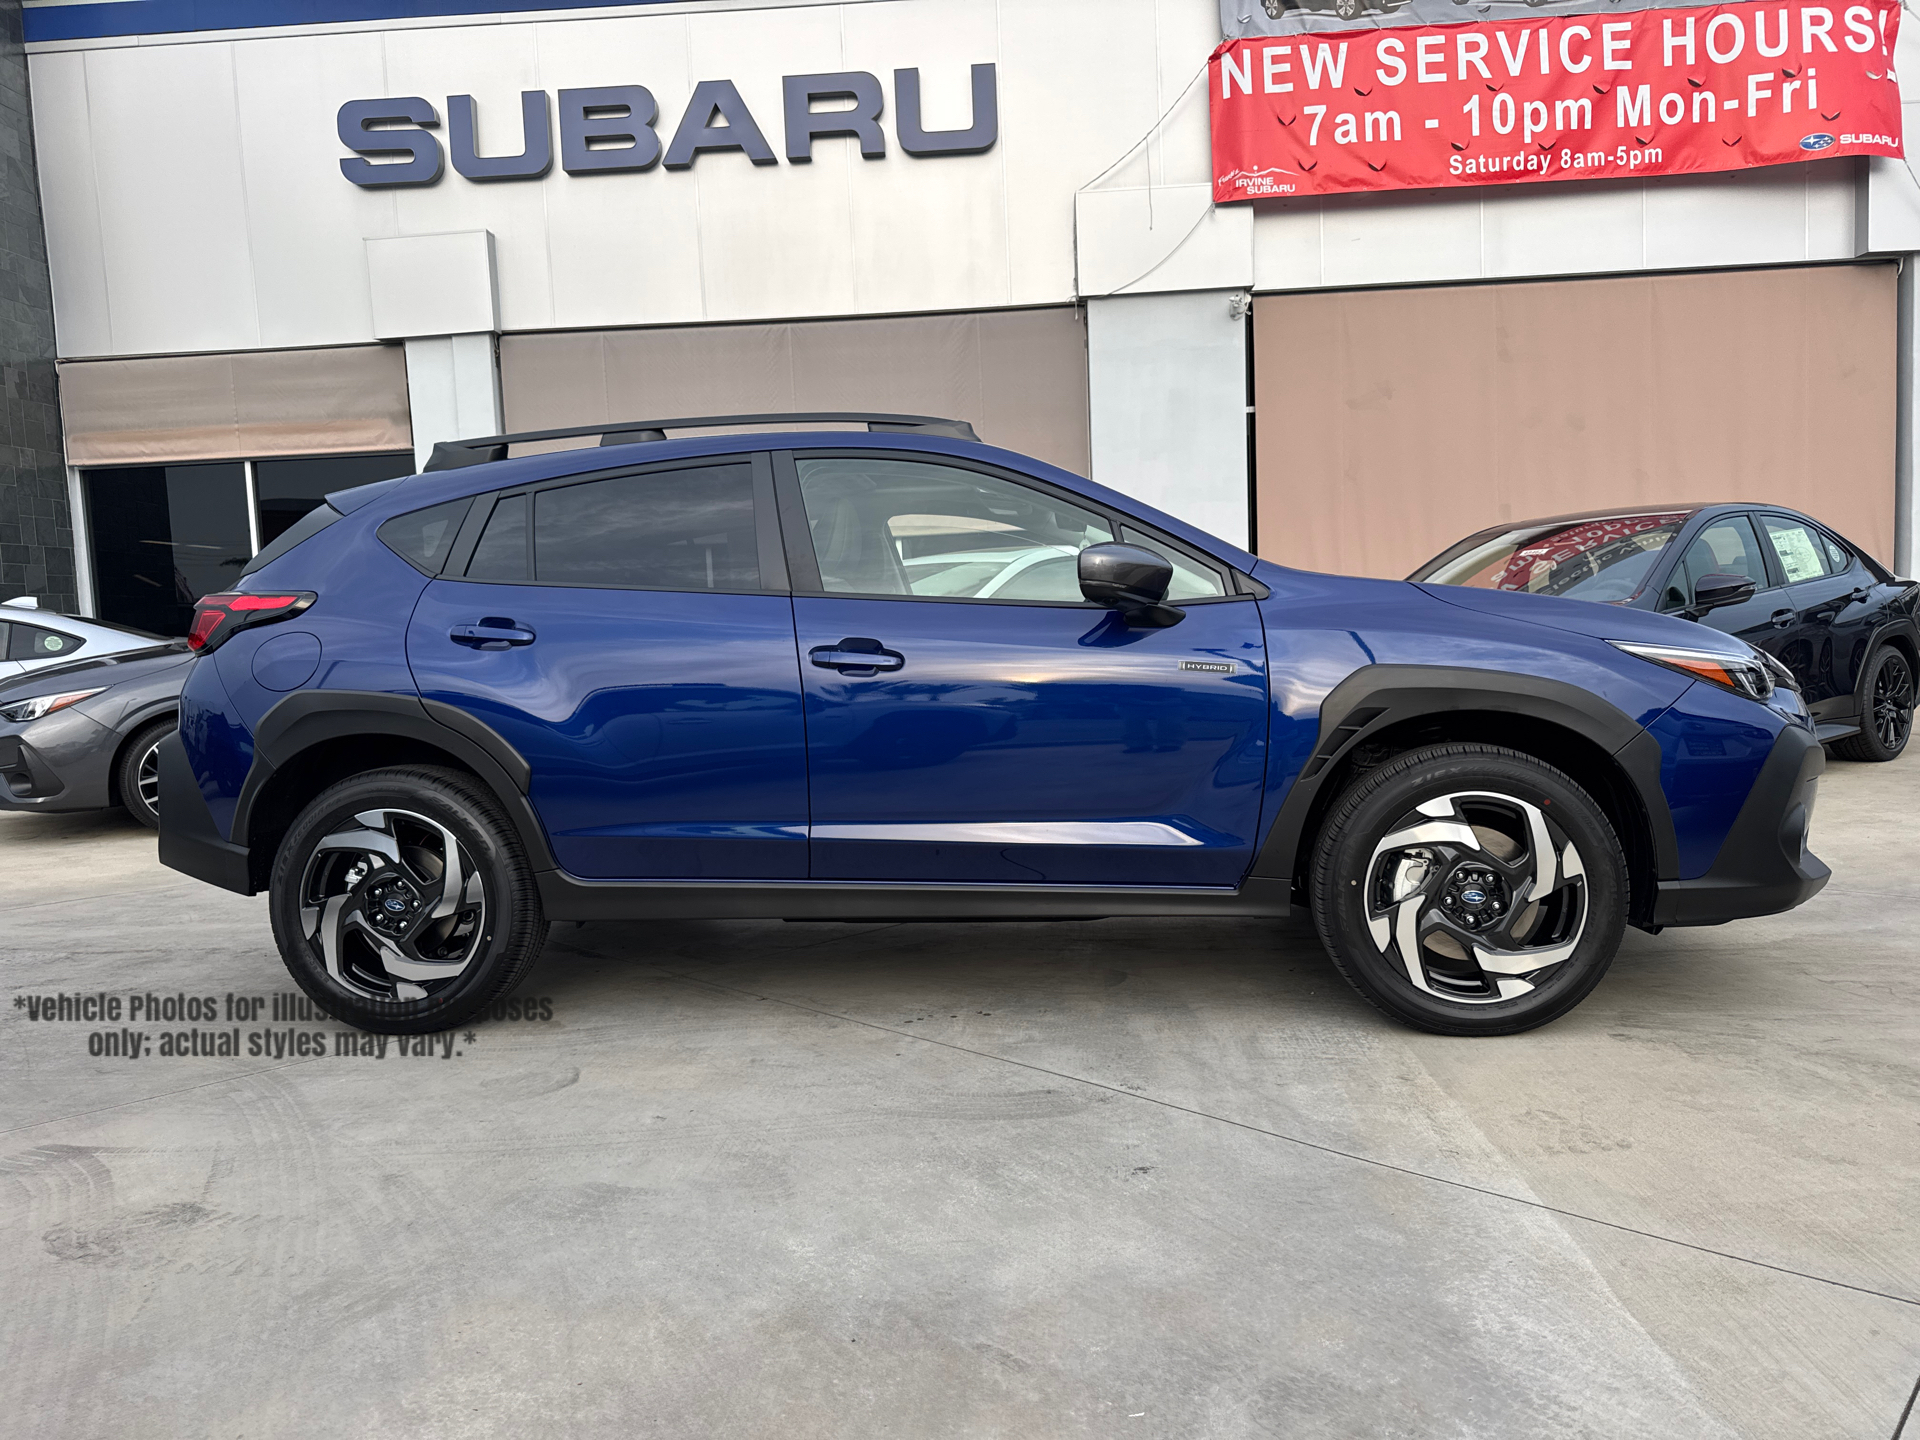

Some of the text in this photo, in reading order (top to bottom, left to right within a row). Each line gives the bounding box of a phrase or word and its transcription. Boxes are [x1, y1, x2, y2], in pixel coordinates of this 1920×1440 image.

[1220, 5, 1888, 100] NEW SERVICE HOURS!
[1303, 105, 1402, 146] 7am
[1462, 93, 1593, 143] 10pm
[1616, 68, 1818, 128] Mon-Fri
[336, 62, 998, 188] SUBARU
[1840, 134, 1899, 147] SUBARU
[1449, 146, 1663, 175] Saturday 8am-5pm
[1236, 177, 1274, 188] IRVINE
[1246, 183, 1296, 195] SUBARU
[1187, 663, 1228, 671] HYBRID
